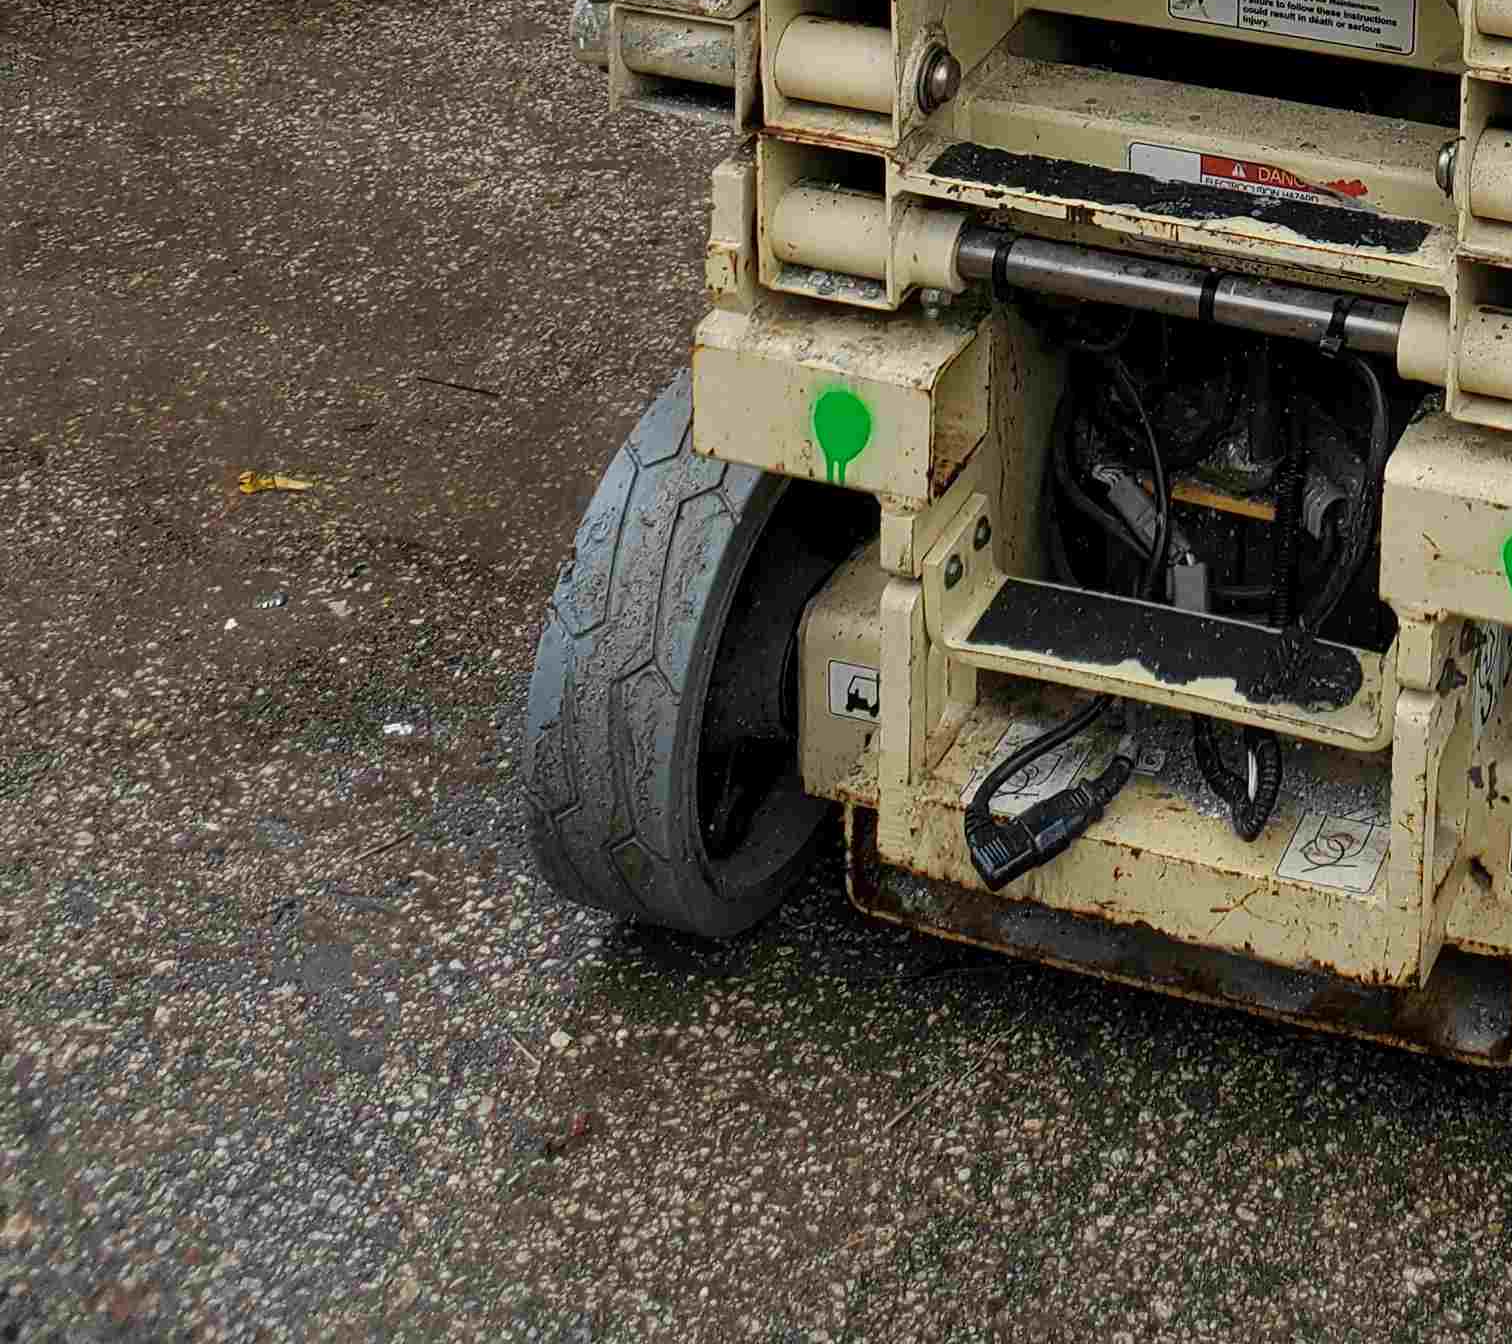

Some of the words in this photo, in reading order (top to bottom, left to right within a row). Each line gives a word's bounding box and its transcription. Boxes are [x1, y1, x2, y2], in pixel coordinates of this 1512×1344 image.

[1242, 6, 1269, 17] could
[1270, 10, 1296, 21] result
[1297, 14, 1307, 23] in
[1308, 15, 1334, 28] death
[1335, 20, 1346, 29] or
[1347, 22, 1382, 35] serious
[1275, 0, 1285, 9] to
[1287, 1, 1314, 13] follow
[1316, 6, 1342, 18] these
